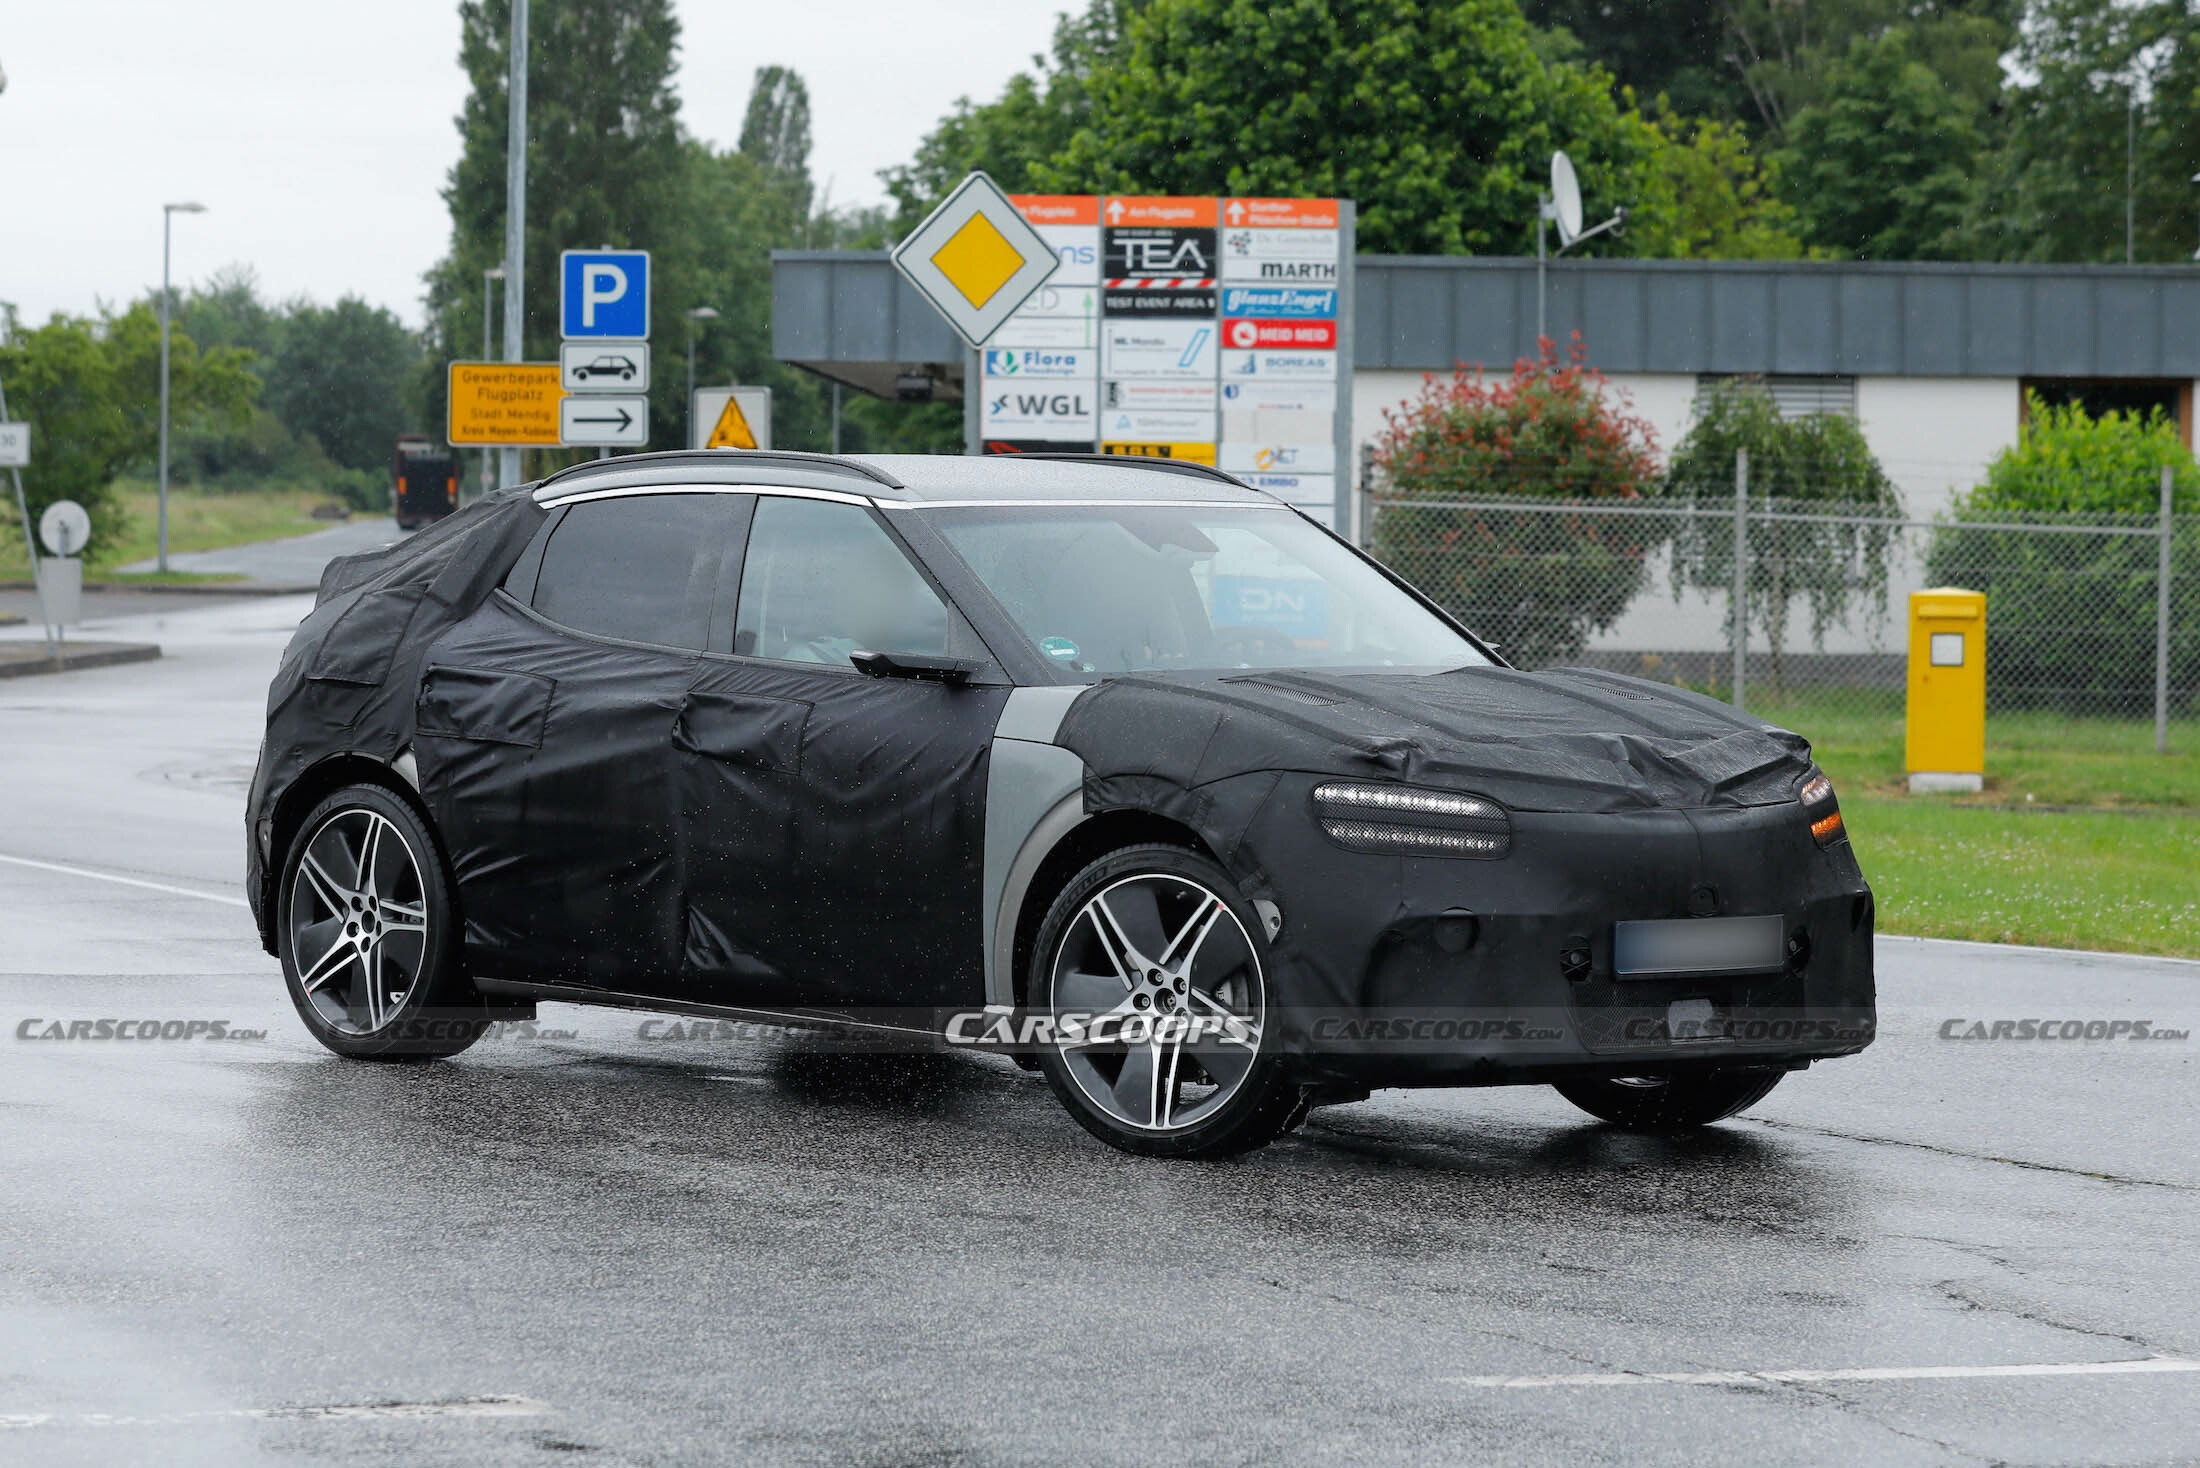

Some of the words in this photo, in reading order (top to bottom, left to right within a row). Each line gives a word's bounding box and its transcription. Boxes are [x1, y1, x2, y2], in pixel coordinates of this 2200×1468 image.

[1053, 246, 1096, 264] ns
[1112, 239, 1208, 270] TEA
[582, 264, 629, 328] P
[1106, 297, 1134, 309] TEST
[1135, 297, 1172, 309] EVENT
[1173, 297, 1206, 309] AREA
[1023, 351, 1077, 366] Flora
[461, 369, 560, 387] Gewerbepark
[477, 386, 544, 404] Flugplatz
[1016, 394, 1090, 416] WGL
